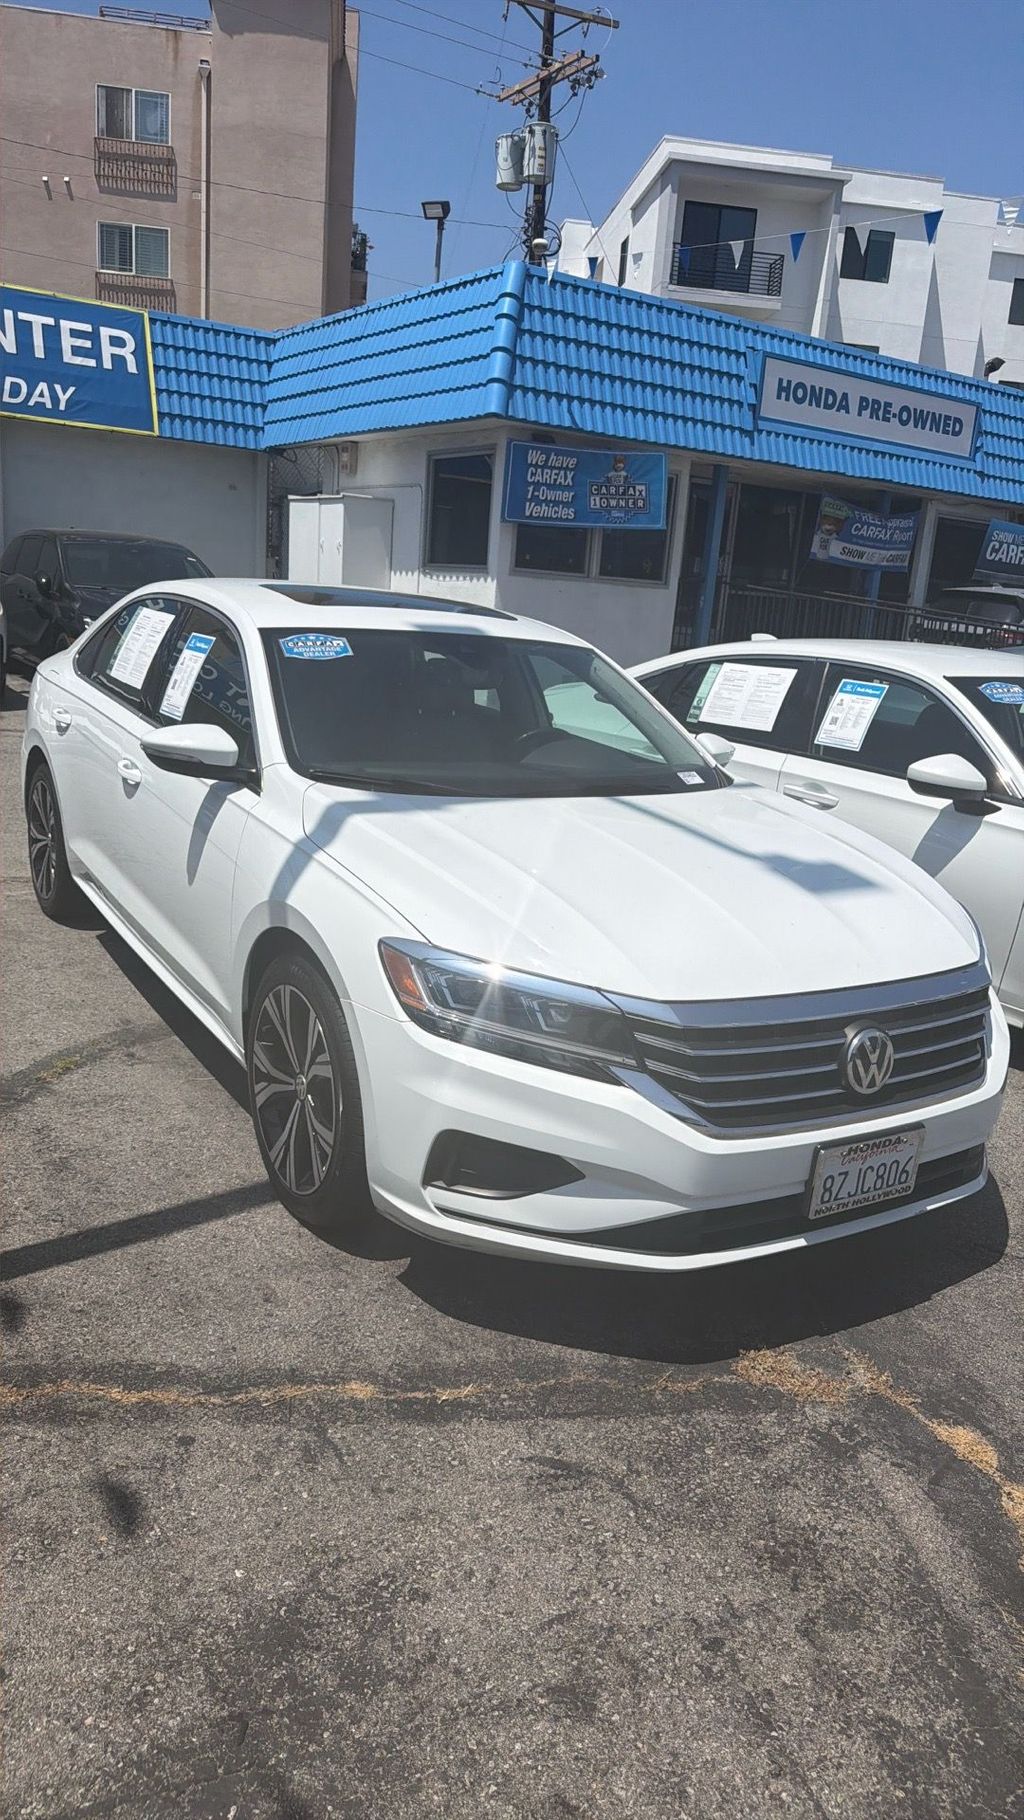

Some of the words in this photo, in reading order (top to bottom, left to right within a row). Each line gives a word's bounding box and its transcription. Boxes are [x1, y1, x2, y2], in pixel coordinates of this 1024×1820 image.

[3, 376, 76, 411] DAY
[776, 377, 850, 414] HONDA
[857, 396, 964, 437] PRE-OWNED
[527, 450, 546, 466] We
[548, 454, 577, 468] have
[527, 467, 574, 486] CARFAX
[527, 486, 574, 502] 1-Owner
[591, 485, 645, 497] CARFAX
[525, 502, 575, 519] Vehicles
[854, 511, 881, 525] FREE
[851, 523, 893, 540] CARFAX
[992, 530, 1014, 544] SHOW
[840, 546, 866, 560] SHOW
[847, 1136, 902, 1155] HONDA
[821, 1155, 914, 1205] 8ZJC806
[814, 1201, 850, 1217] NORTH
[851, 1185, 912, 1207] HOLLYWOOD
